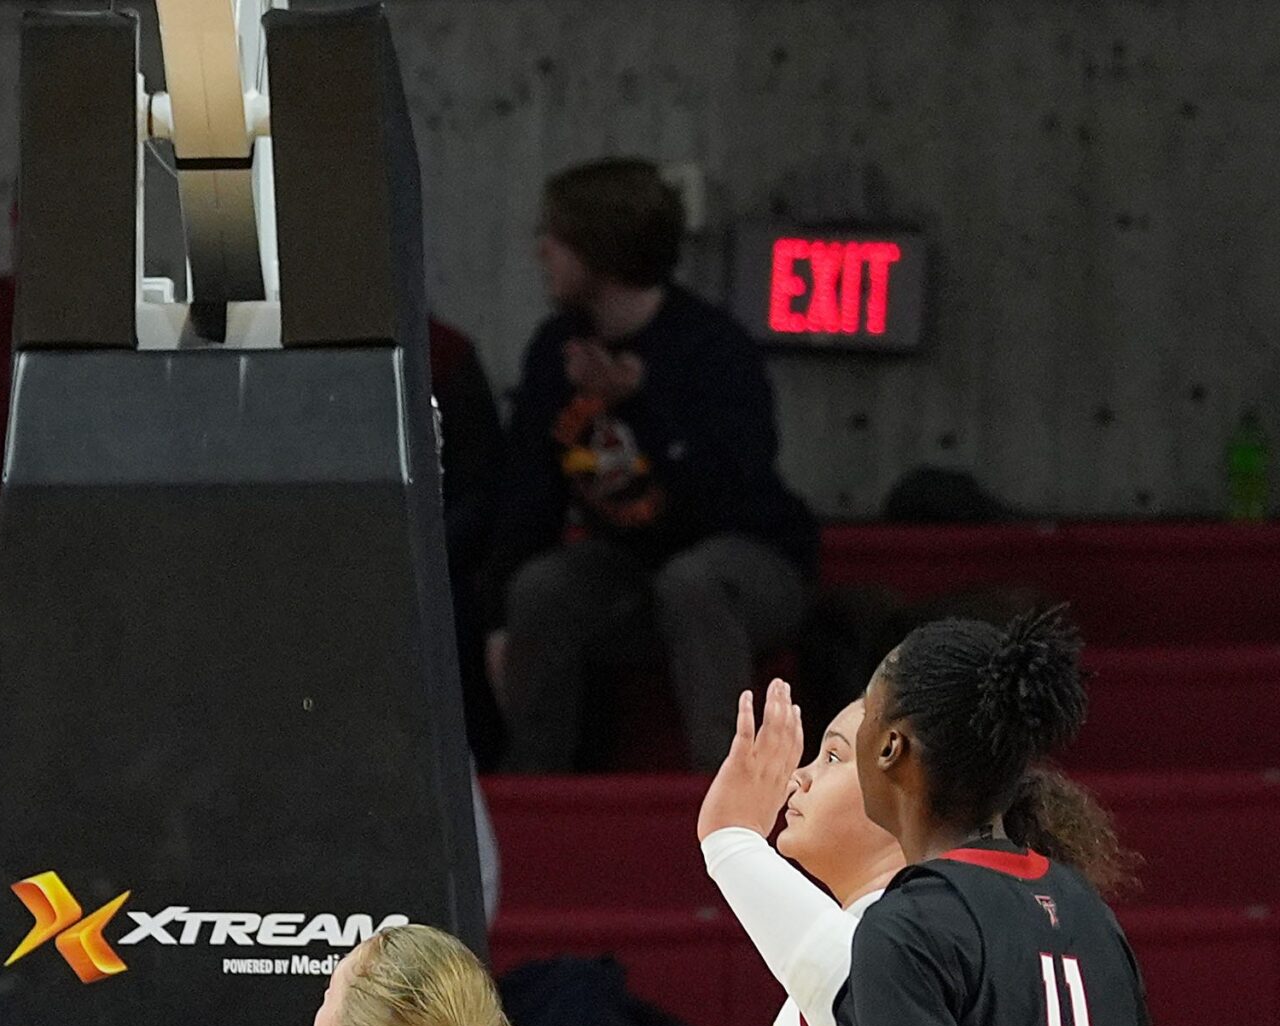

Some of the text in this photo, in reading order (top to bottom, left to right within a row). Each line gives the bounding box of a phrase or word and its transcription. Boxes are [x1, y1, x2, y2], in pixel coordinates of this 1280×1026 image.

[769, 238, 901, 334] EXIT
[119, 906, 409, 946] XTREAM
[223, 958, 273, 975] POWERED
[274, 958, 289, 975] BY
